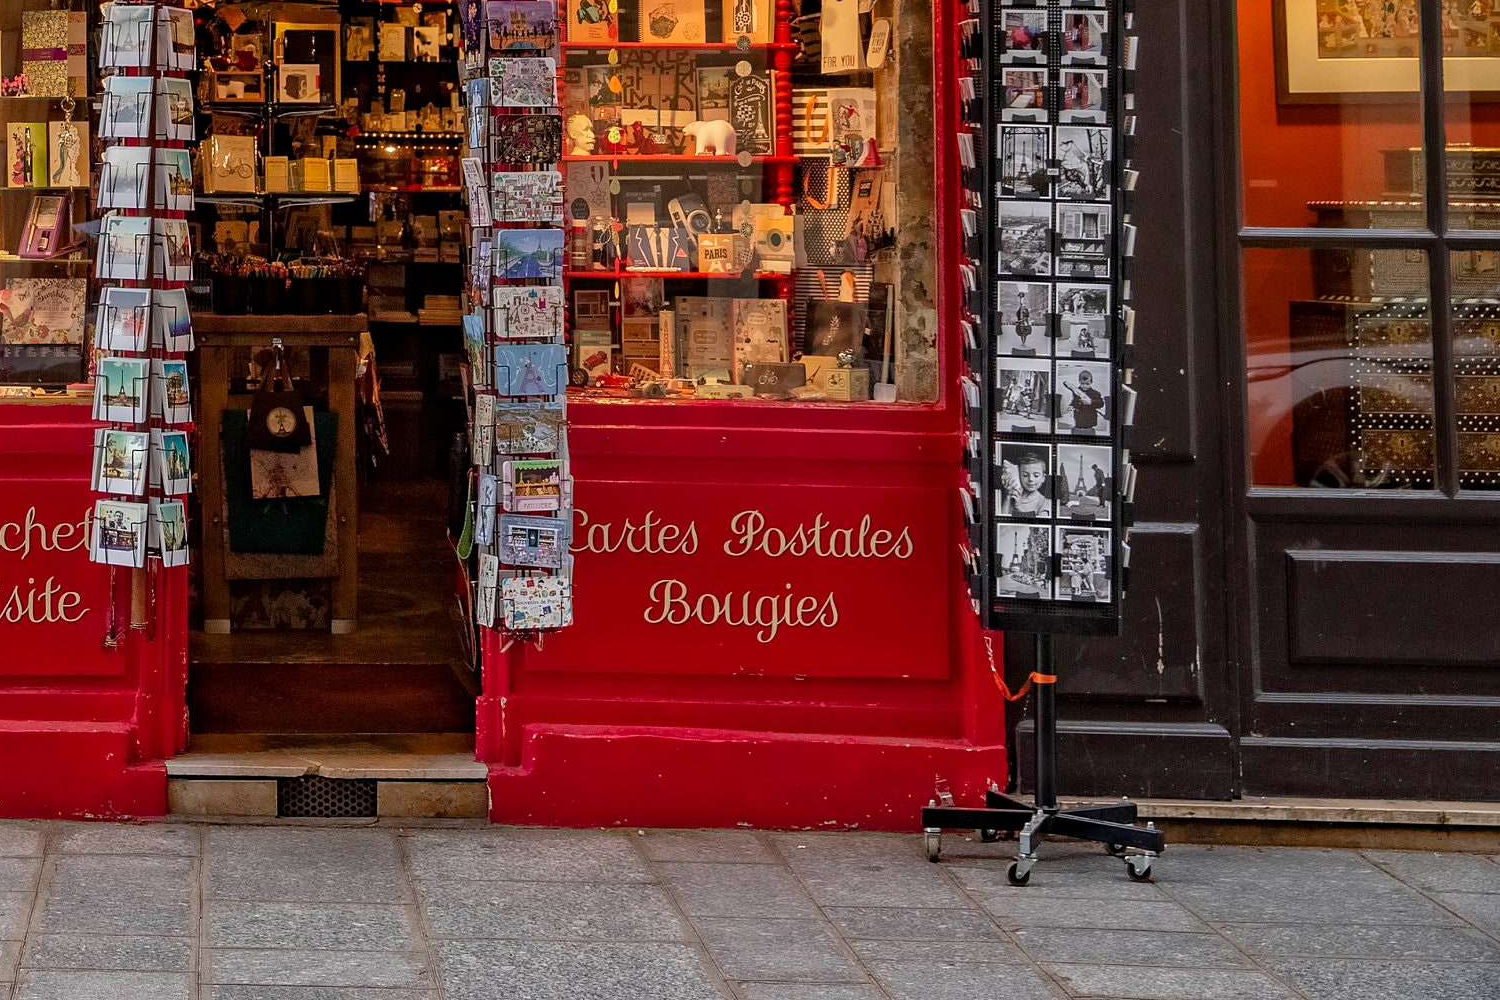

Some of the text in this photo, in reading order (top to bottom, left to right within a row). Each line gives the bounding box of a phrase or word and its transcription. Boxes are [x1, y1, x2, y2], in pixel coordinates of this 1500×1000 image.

[823, 54, 856, 68] FOR YOU
[704, 248, 728, 260] PARIS
[34, 289, 71, 303] Sunshine
[724, 509, 914, 560] Postales
[643, 578, 840, 644] Bougies
